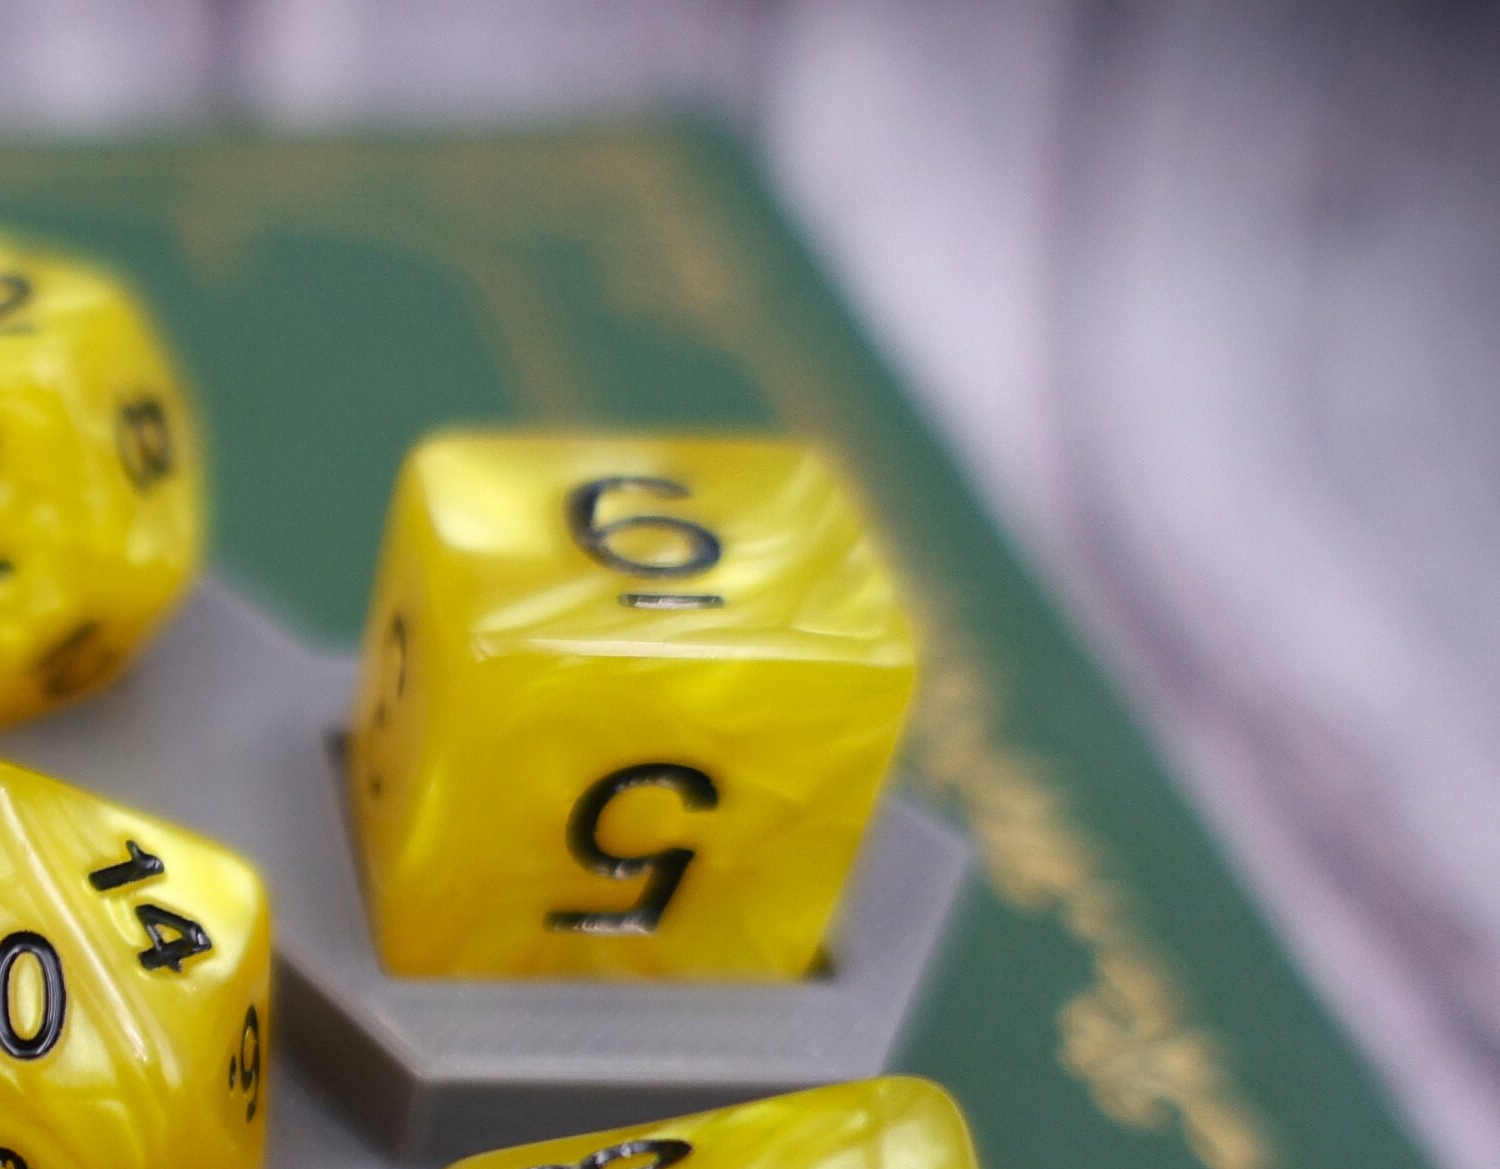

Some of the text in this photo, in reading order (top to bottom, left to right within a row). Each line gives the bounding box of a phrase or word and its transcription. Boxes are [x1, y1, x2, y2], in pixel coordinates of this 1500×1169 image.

[566, 477, 723, 607] 6
[88, 840, 212, 973] 14
[547, 762, 719, 930] 5
